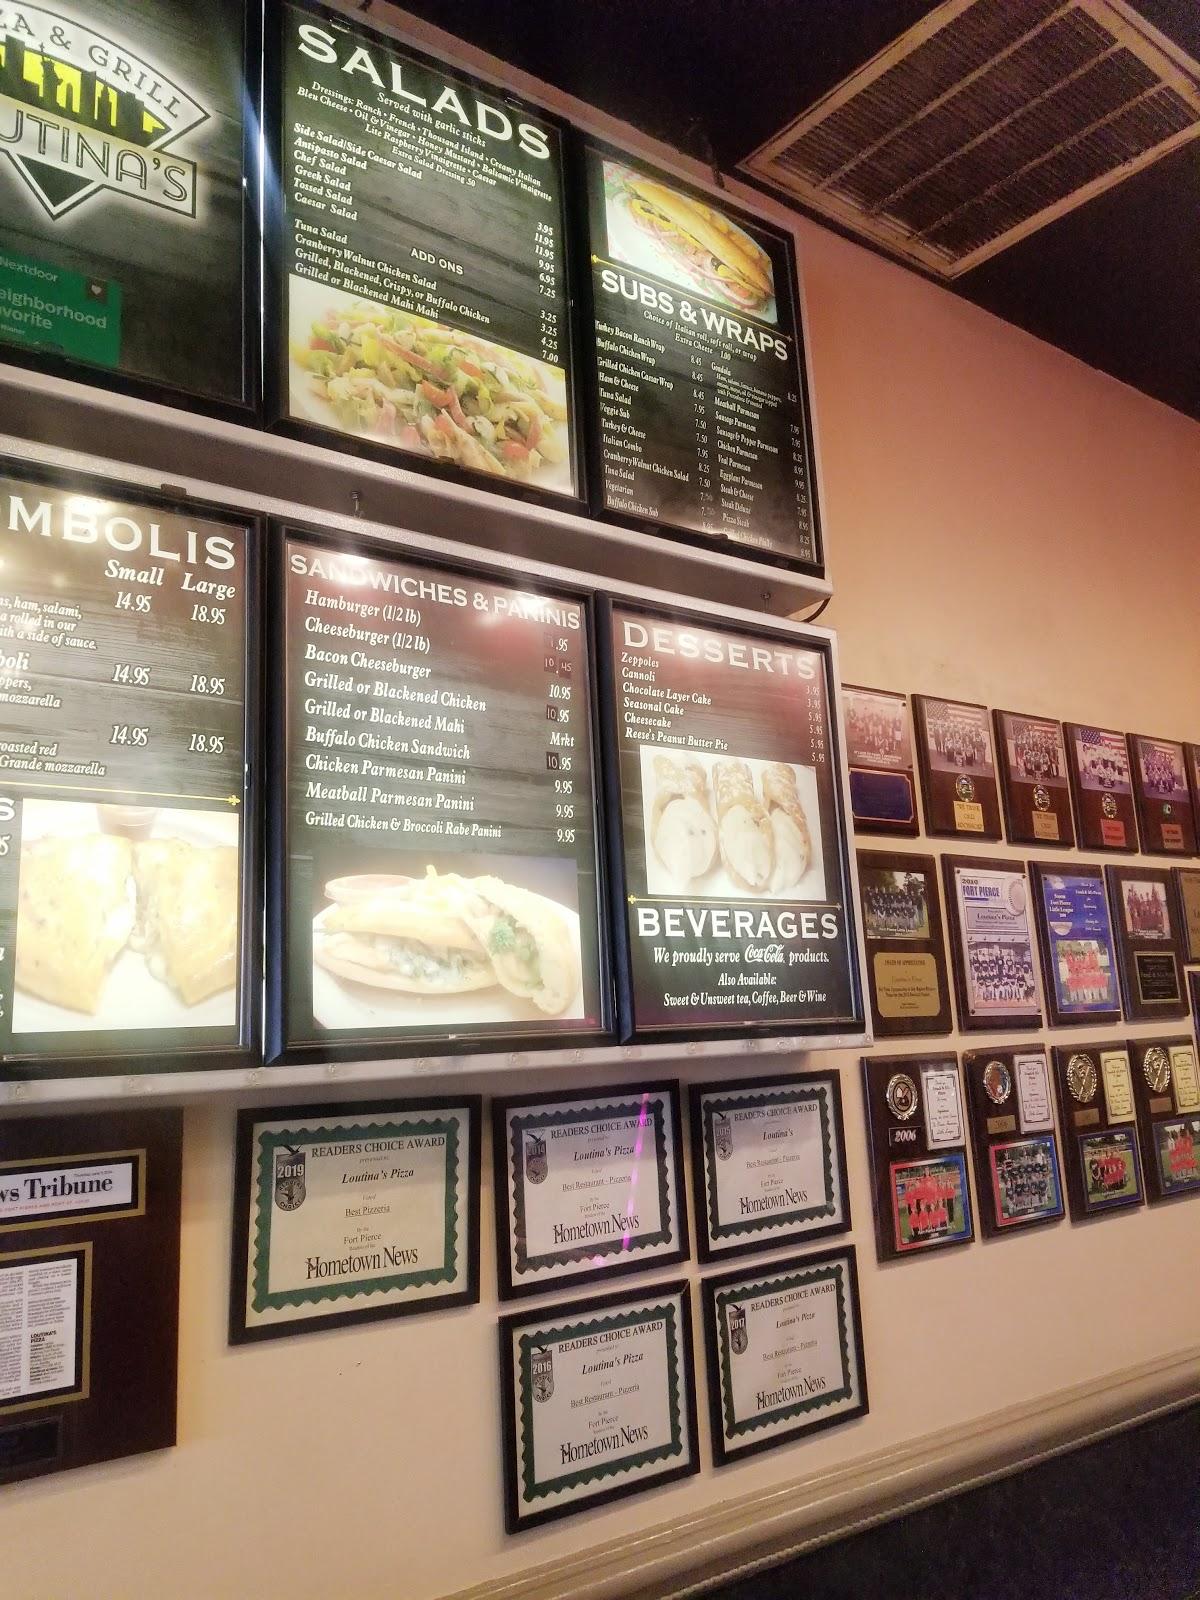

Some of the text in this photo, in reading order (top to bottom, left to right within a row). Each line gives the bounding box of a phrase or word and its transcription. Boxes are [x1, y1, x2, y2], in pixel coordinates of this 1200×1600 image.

[50, 26, 181, 118] & GRILL
[298, 24, 550, 159] SALADS
[377, 92, 486, 147] Served with garlic sticks
[294, 137, 367, 169] Antipasto Salad
[294, 150, 346, 175] Chef Salad
[294, 193, 357, 221] Caesar Salad
[294, 219, 348, 244] Tuna Salad
[534, 233, 554, 248] 11.95
[536, 222, 554, 236] 3.95
[410, 248, 464, 275] ADD ONS
[295, 262, 439, 319] Grilled or Blackened Mahi Mahi
[540, 310, 557, 323] 3.25
[601, 270, 788, 361] SUBS & WRAPS
[675, 333, 693, 347] Extra
[541, 349, 559, 363] 7.00
[615, 393, 631, 405] Salad
[8, 496, 235, 569] MBOLIS
[104, 559, 236, 600] Small Large
[290, 554, 580, 630] SANDWICHES & PANINIS
[306, 590, 380, 617] Hamburger
[115, 591, 226, 625] 14.95 18.95
[27, 630, 49, 643] side
[51, 634, 62, 647] of
[305, 617, 390, 645] Cheeseburger
[305, 644, 432, 679] Bacon Cheeseburger
[621, 652, 659, 668] Zeppoles
[623, 621, 816, 680] DESSERTS
[112, 664, 225, 695] 14.95 18.95
[622, 668, 655, 681] Cannoli
[304, 672, 486, 712] Grilled or Blackened Chicken
[550, 684, 572, 700] 10.95
[623, 682, 712, 705] Chocolate Layer Cake
[304, 699, 465, 734] Grilled or Blackened Mahi
[624, 697, 684, 716] Seasonal Cake
[624, 712, 672, 728] Cheesecake
[39, 744, 58, 756] red
[110, 725, 224, 754] 14.95 18.95
[306, 726, 471, 760] Buffalo Chicken Sandwich
[550, 732, 574, 747] Mrkt
[625, 727, 728, 751] Reese's Peanut Butter Pie
[811, 740, 824, 749] 5.95
[0, 755, 106, 776] Grande mozzarella
[306, 754, 466, 785] Chicken Parmesan Panini
[306, 782, 474, 812] Meatball Parmesan Panini
[554, 780, 572, 794] 9.95
[556, 804, 574, 818] 9.95
[306, 812, 502, 838] Grilled Chicken & Broccoli Rabe Panini
[557, 829, 576, 843] 9.95
[962, 886, 1000, 897] FORT PIERCE
[637, 907, 839, 940] BEVERAGES
[654, 947, 670, 963] We
[672, 948, 713, 966] proudly
[715, 951, 740, 963] serve
[789, 949, 829, 966] products.
[718, 973, 776, 986] Also Available:
[664, 990, 826, 1007] Sweet & Unsweet tea, Coffee, Beer & Wine
[311, 1137, 445, 1157] READERS CHOICE AWARD
[894, 1130, 916, 1141] 2006
[574, 1146, 634, 1161] Loutina's Pizza
[277, 1164, 304, 1178] 2019
[342, 1168, 414, 1184] Loutina's Pizza
[24, 1175, 112, 1200] Tribune
[345, 1208, 361, 1216] Best
[344, 1233, 381, 1245] Fort Pierce
[553, 1213, 639, 1244] Hometown News
[306, 1246, 418, 1279] Hometown News
[751, 1283, 835, 1311] READERS CHOICE AWARD
[560, 1424, 648, 1464] Hometown News
